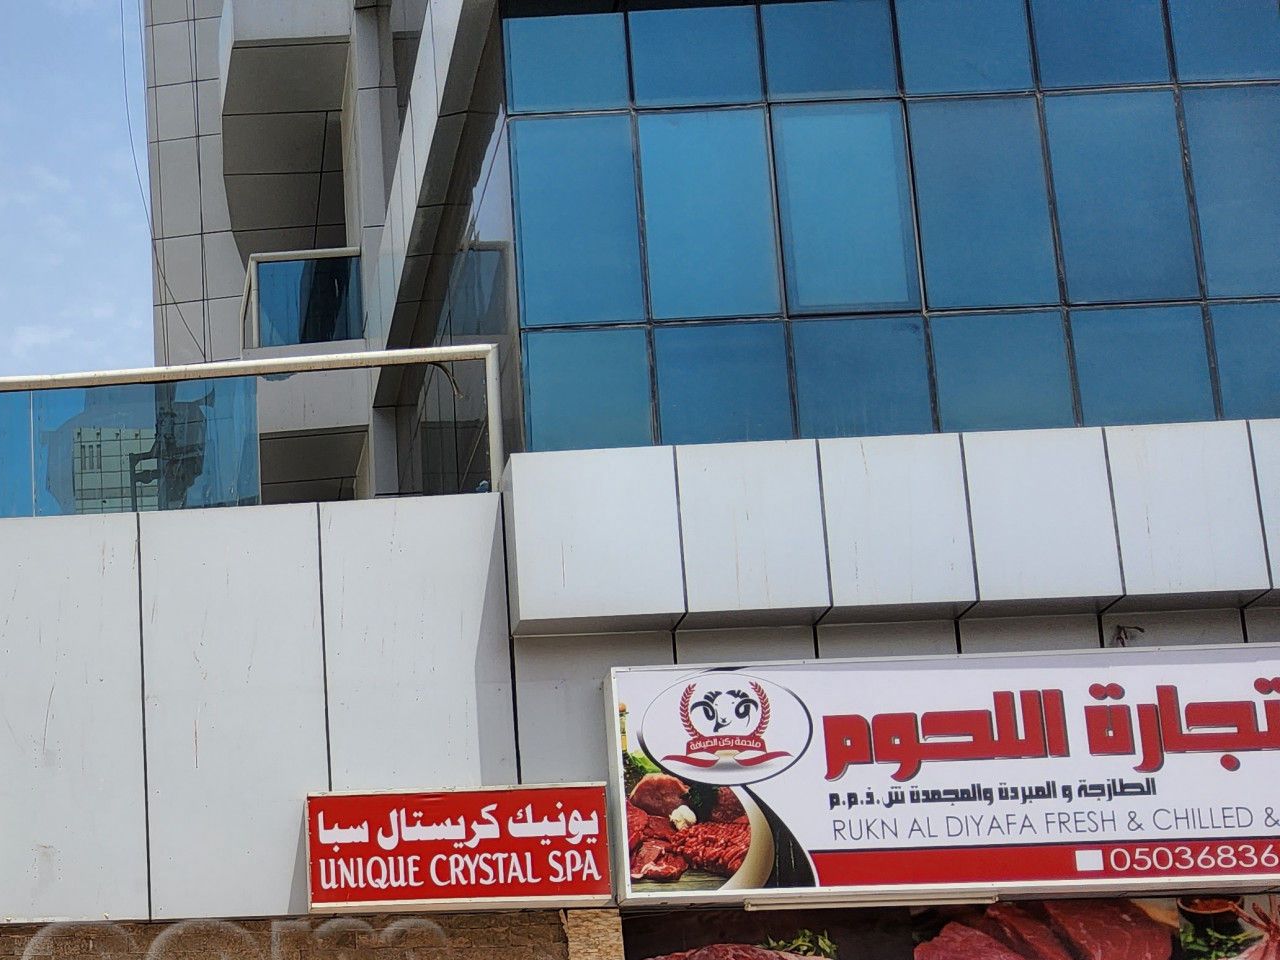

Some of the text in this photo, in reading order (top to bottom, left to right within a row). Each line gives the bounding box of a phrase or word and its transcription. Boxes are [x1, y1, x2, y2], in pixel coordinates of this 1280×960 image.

[822, 689, 1070, 782] اللحوم
[909, 783, 994, 806] والمجمدة
[998, 780, 1058, 805] المبردة
[1077, 777, 1157, 802] الطازجة
[317, 802, 599, 852] يونيك كريستال سبا
[833, 817, 898, 841] RUKN
[908, 816, 938, 839] AL
[945, 813, 1037, 838] DIYAFA
[1045, 810, 1116, 834] FRESH
[1127, 810, 1145, 832] &
[1152, 806, 1253, 831] CHILLED
[319, 850, 602, 890] UNIQUE CRYSTAL SPA
[1110, 844, 1280, 872] 05036836
